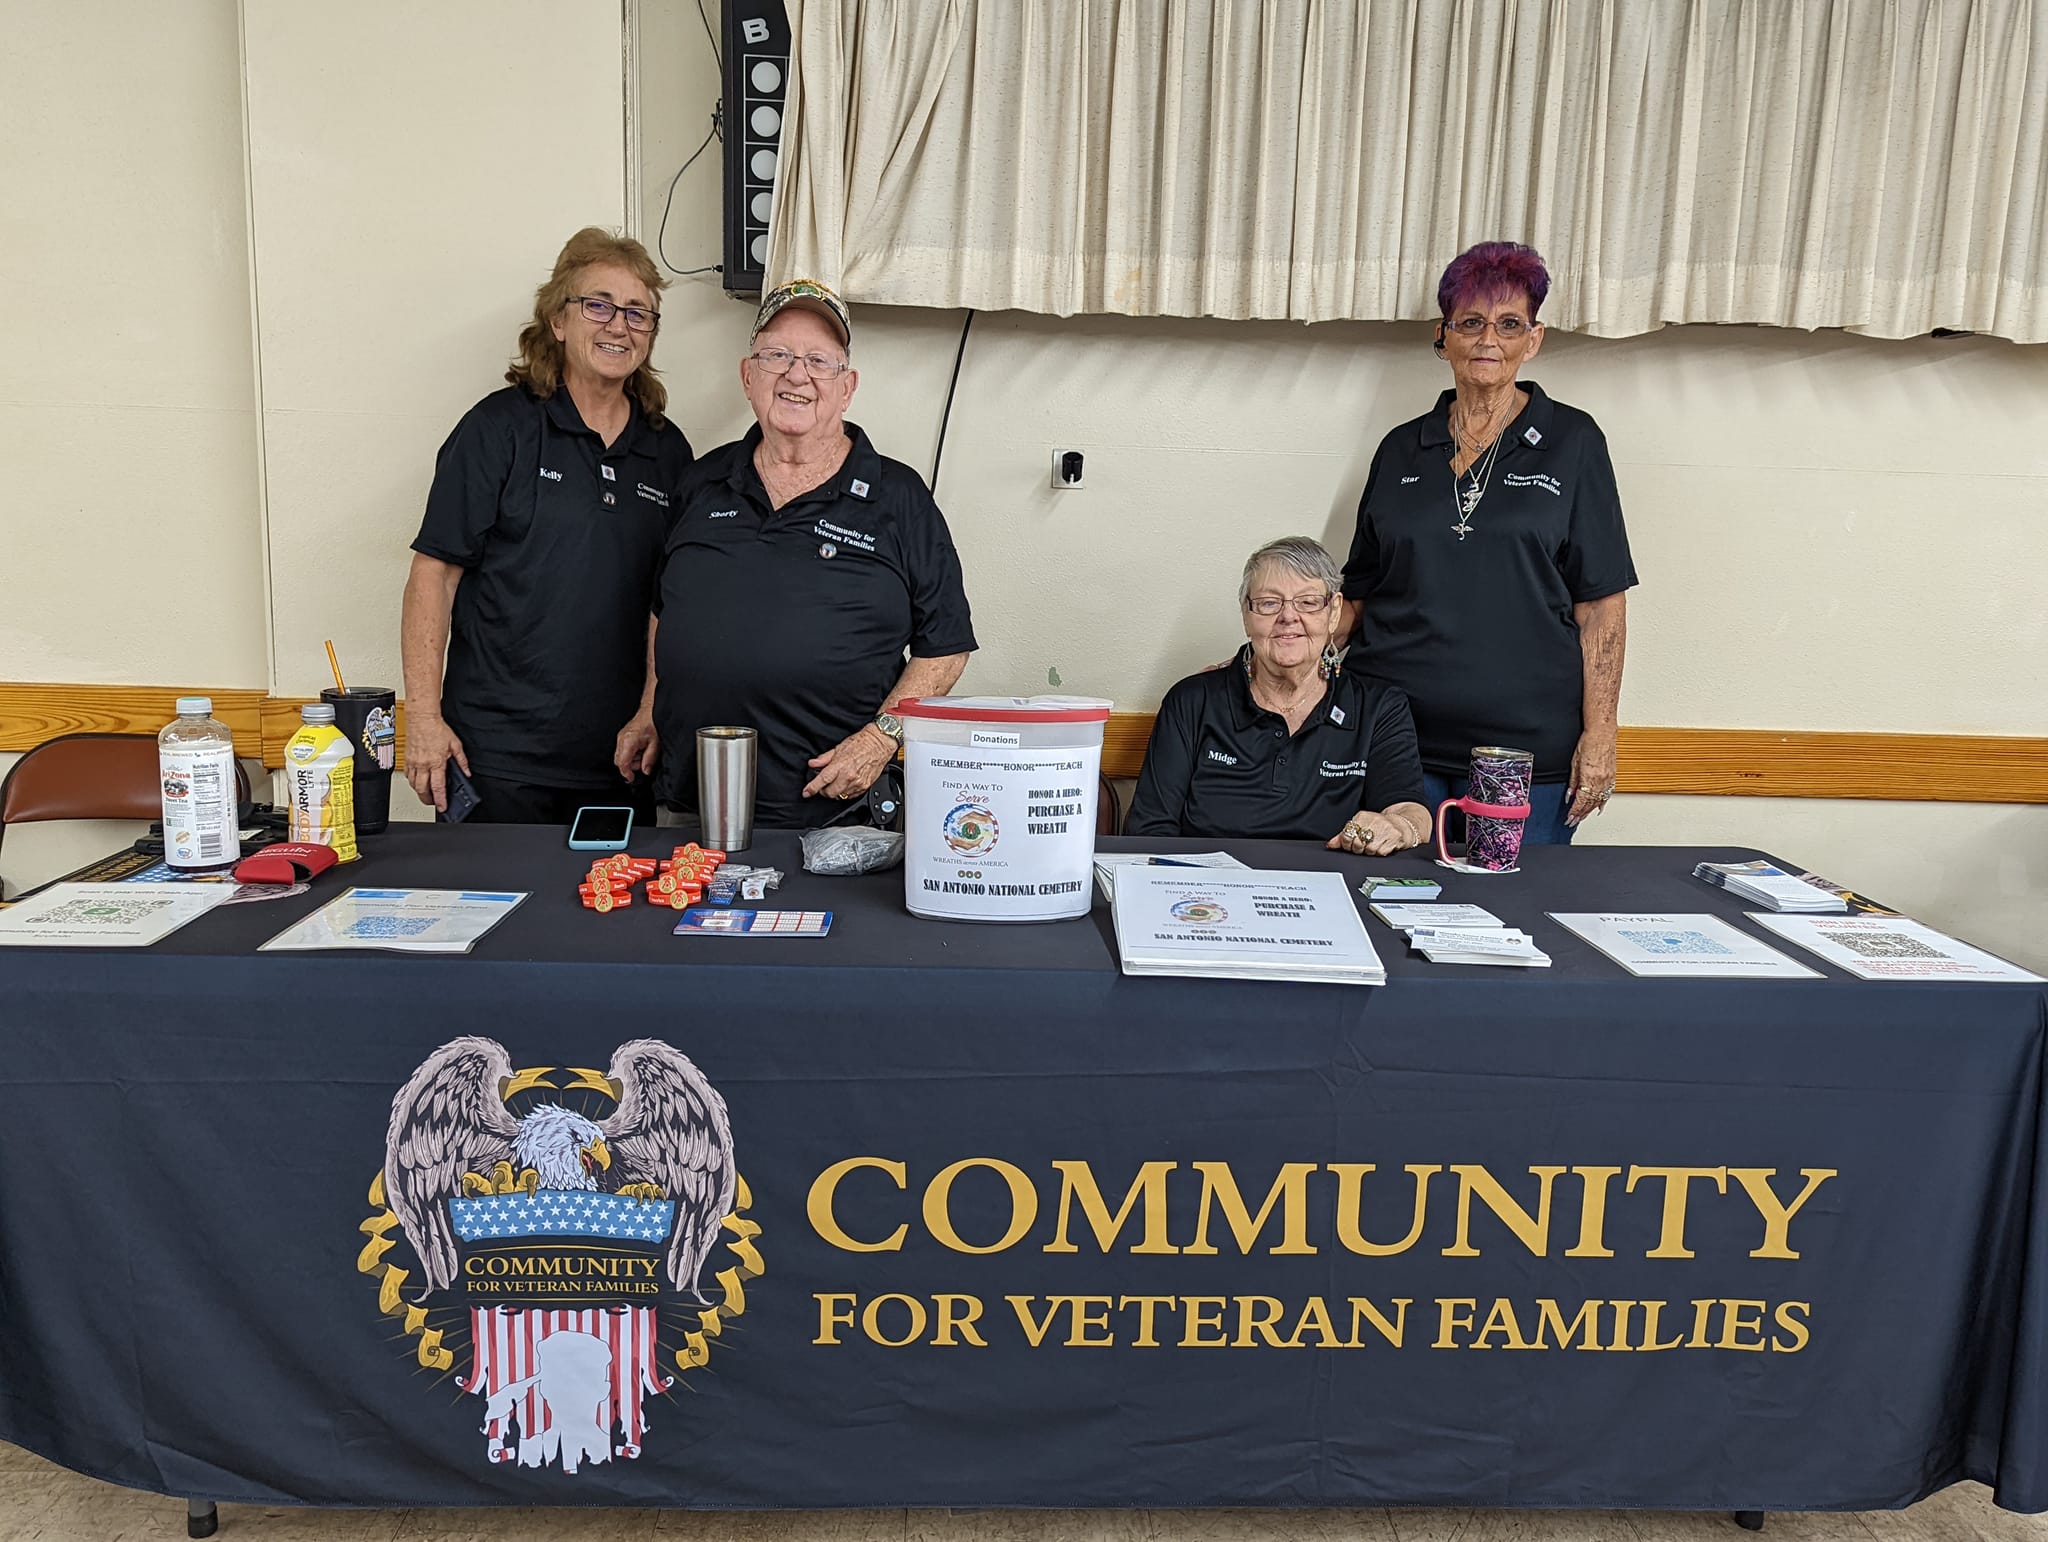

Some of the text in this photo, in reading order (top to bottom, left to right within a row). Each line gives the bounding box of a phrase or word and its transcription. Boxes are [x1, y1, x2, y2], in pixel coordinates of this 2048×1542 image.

[742, 17, 770, 44] B
[540, 467, 563, 482] Kelly
[1400, 475, 1420, 485] Star
[1507, 473, 1561, 487] Community for
[1503, 479, 1560, 496] Veteran Families
[709, 510, 738, 519] Shorty
[819, 519, 876, 543] Community for
[814, 525, 875, 552] Veteran Families
[973, 734, 1018, 745] Donations
[1208, 750, 1237, 765] Midge
[307, 769, 315, 789] LYTE
[942, 781, 962, 790] FIND
[972, 783, 990, 791] WAY
[955, 791, 990, 803] Serve
[1028, 788, 1083, 799] HONOR A HERO:
[297, 769, 311, 841] BODYARMOR
[1028, 803, 1083, 817] PURCHASE A
[1028, 822, 1068, 835] WREATH
[933, 856, 963, 865] WREATHS
[978, 860, 1009, 868] AMERICA
[923, 879, 1083, 896] SAN ANTONIO NATIONAL CEMETERY
[1254, 902, 1307, 911] PURCHASE
[1256, 910, 1301, 918] WREATH
[1176, 934, 1223, 942] ANTONIO
[1225, 935, 1278, 944] NATIONAL
[1279, 938, 1333, 946] CEMETERY
[806, 1156, 1838, 1260] COMMUNITY
[464, 1256, 661, 1277] COMMUNITY
[467, 1281, 660, 1294] FOR VETERAN FAMILIES
[811, 1293, 1811, 1353] FOR VETERAN FAMILIES
